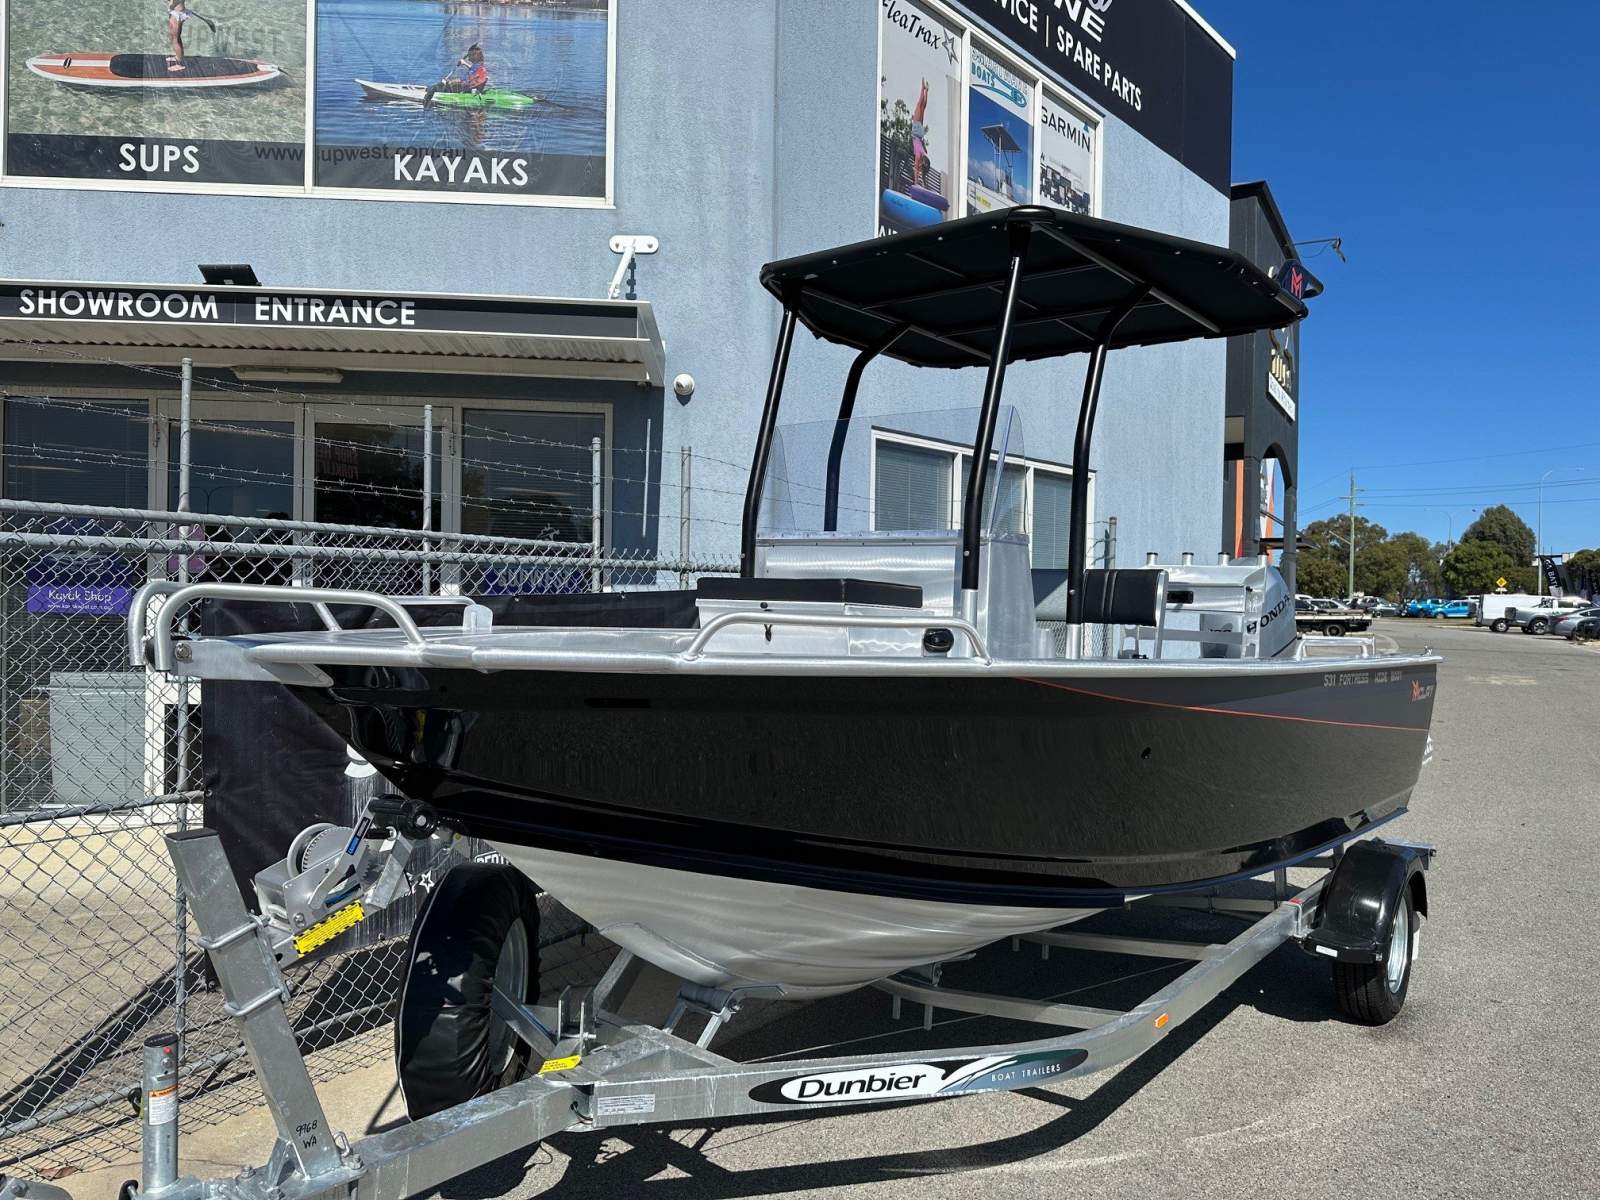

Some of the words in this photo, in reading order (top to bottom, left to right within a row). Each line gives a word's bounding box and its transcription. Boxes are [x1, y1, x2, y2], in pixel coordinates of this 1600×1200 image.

[971, 62, 995, 88] BOATS
[1056, 25, 1101, 81] SPARE
[1104, 62, 1142, 111] PARTS
[119, 142, 200, 174] SUPS
[394, 154, 529, 186] KAYAKS
[19, 288, 219, 319] SHOWROOM
[255, 296, 416, 326] ENTRANCE
[48, 590, 80, 602] Kayak
[85, 591, 112, 604] Shop
[1247, 594, 1290, 634] HONDA
[797, 1073, 926, 1098] Dunbier
[991, 1073, 1016, 1082] BOAT
[1022, 1064, 1061, 1077] TRAILERS
[303, 1134, 317, 1149] WA
